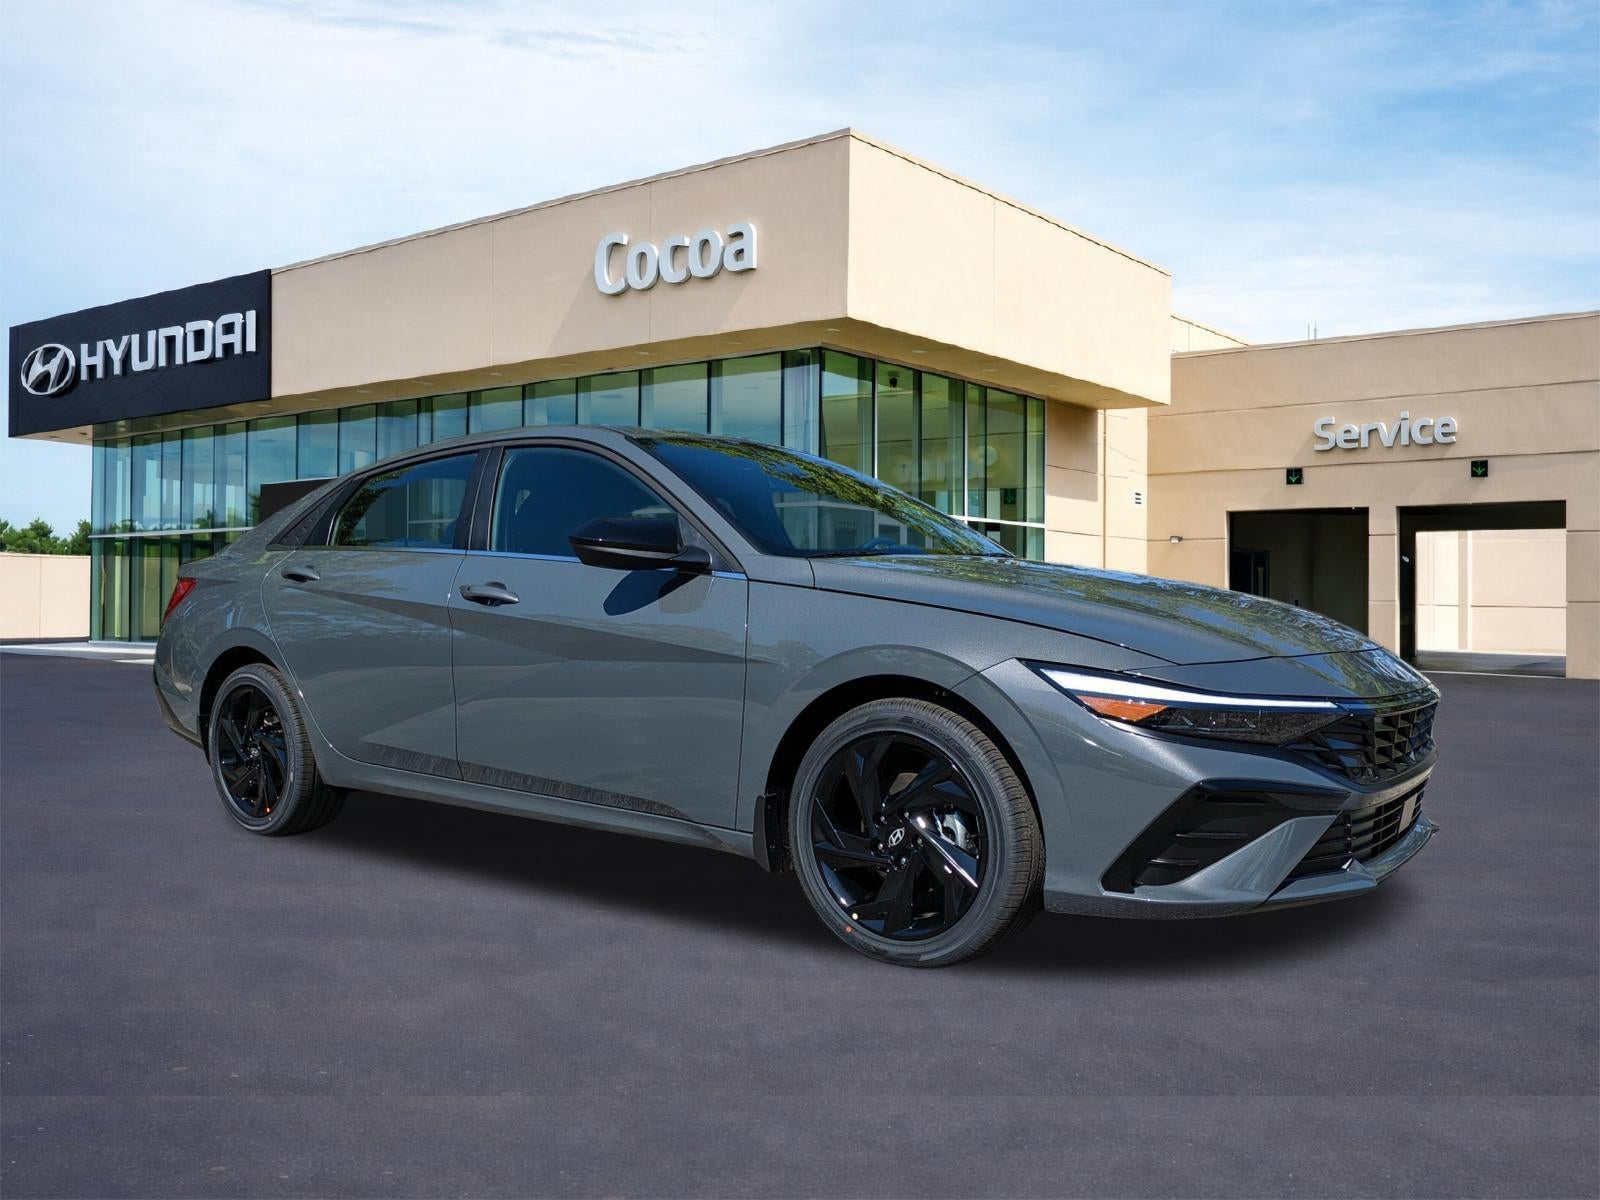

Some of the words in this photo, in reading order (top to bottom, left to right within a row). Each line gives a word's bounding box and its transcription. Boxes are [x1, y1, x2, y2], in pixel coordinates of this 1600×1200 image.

[594, 223, 757, 295] Cocoa
[80, 310, 256, 380] HYUNDAI
[1313, 411, 1457, 451] Service
